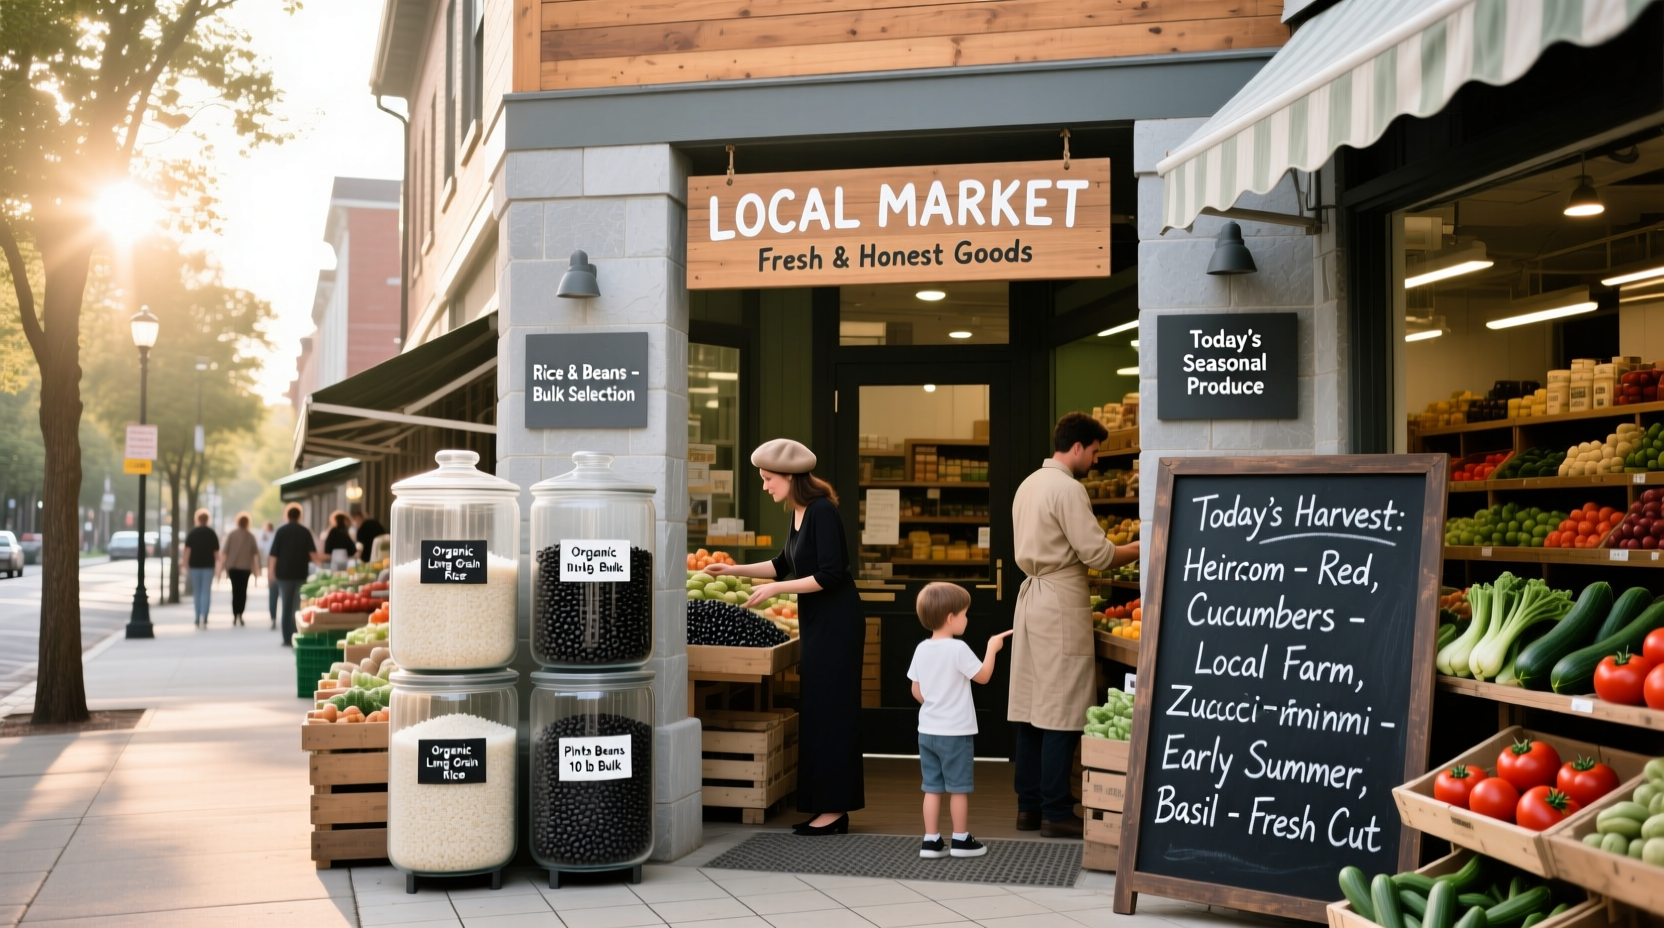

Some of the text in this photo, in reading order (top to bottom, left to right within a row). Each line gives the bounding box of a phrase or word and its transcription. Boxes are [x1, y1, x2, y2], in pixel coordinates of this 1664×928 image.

[709, 179, 1089, 241] LOCAL MARKET
[758, 238, 1033, 272] Fresh & Honest Goods
[1189, 328, 1262, 353] Today's
[533, 364, 564, 380] Rice
[567, 364, 578, 380] &
[582, 363, 627, 380] Beans
[1183, 352, 1267, 372] Seasonal
[533, 385, 635, 402] Bulk Selection
[1187, 376, 1265, 395] Produce
[1193, 494, 1405, 541] Today's Harvest:
[571, 546, 617, 562] Organic
[1318, 549, 1379, 593] Red,
[1187, 591, 1336, 632] Cucumbers
[1194, 640, 1364, 693] Local Farm,
[569, 759, 622, 772] 10 lb Bulk
[1161, 734, 1367, 799] Early Summer,
[1154, 784, 1219, 827] Basil
[1248, 797, 1316, 842] Fresh
[1328, 807, 1381, 852] Cut
